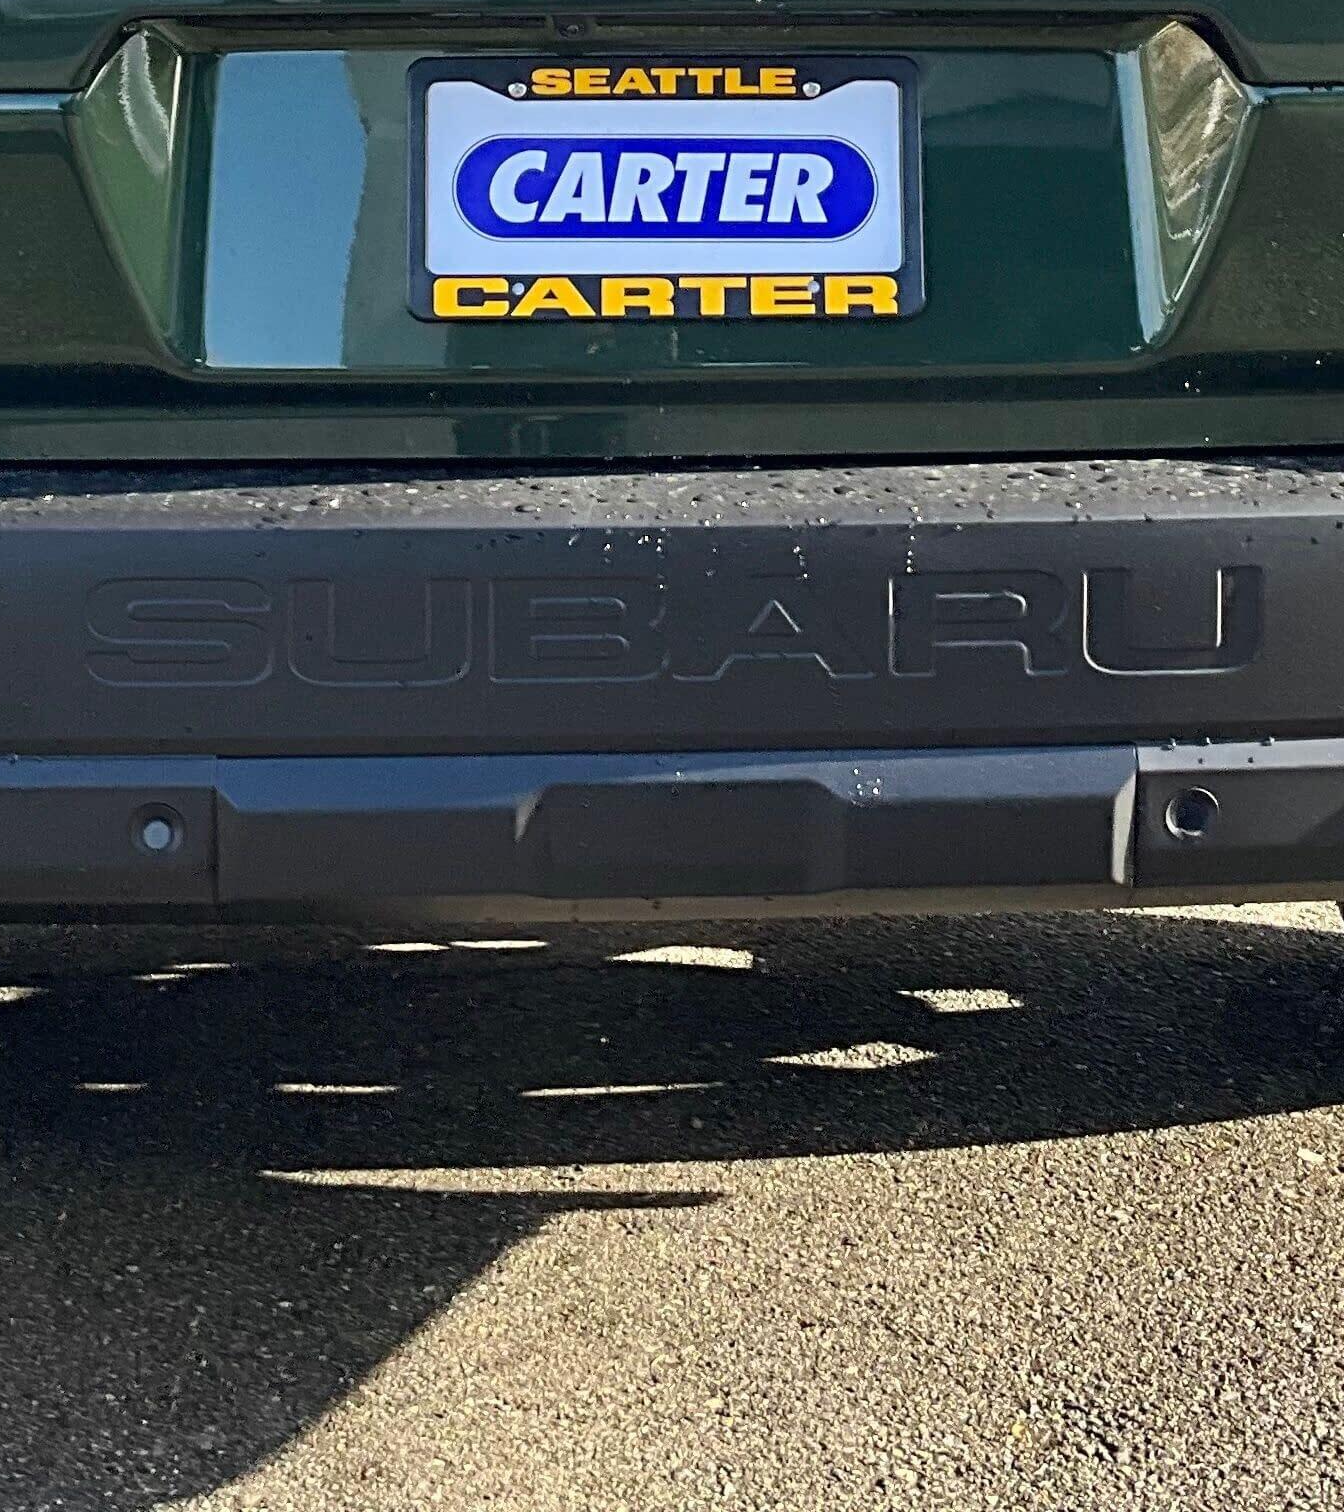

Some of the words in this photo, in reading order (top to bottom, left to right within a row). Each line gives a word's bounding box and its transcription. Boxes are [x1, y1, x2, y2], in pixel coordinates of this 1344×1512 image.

[529, 67, 798, 97] SEATTLE
[487, 149, 836, 227] CARTER
[432, 274, 901, 320] CARTER
[83, 566, 1265, 688] SUBARU
